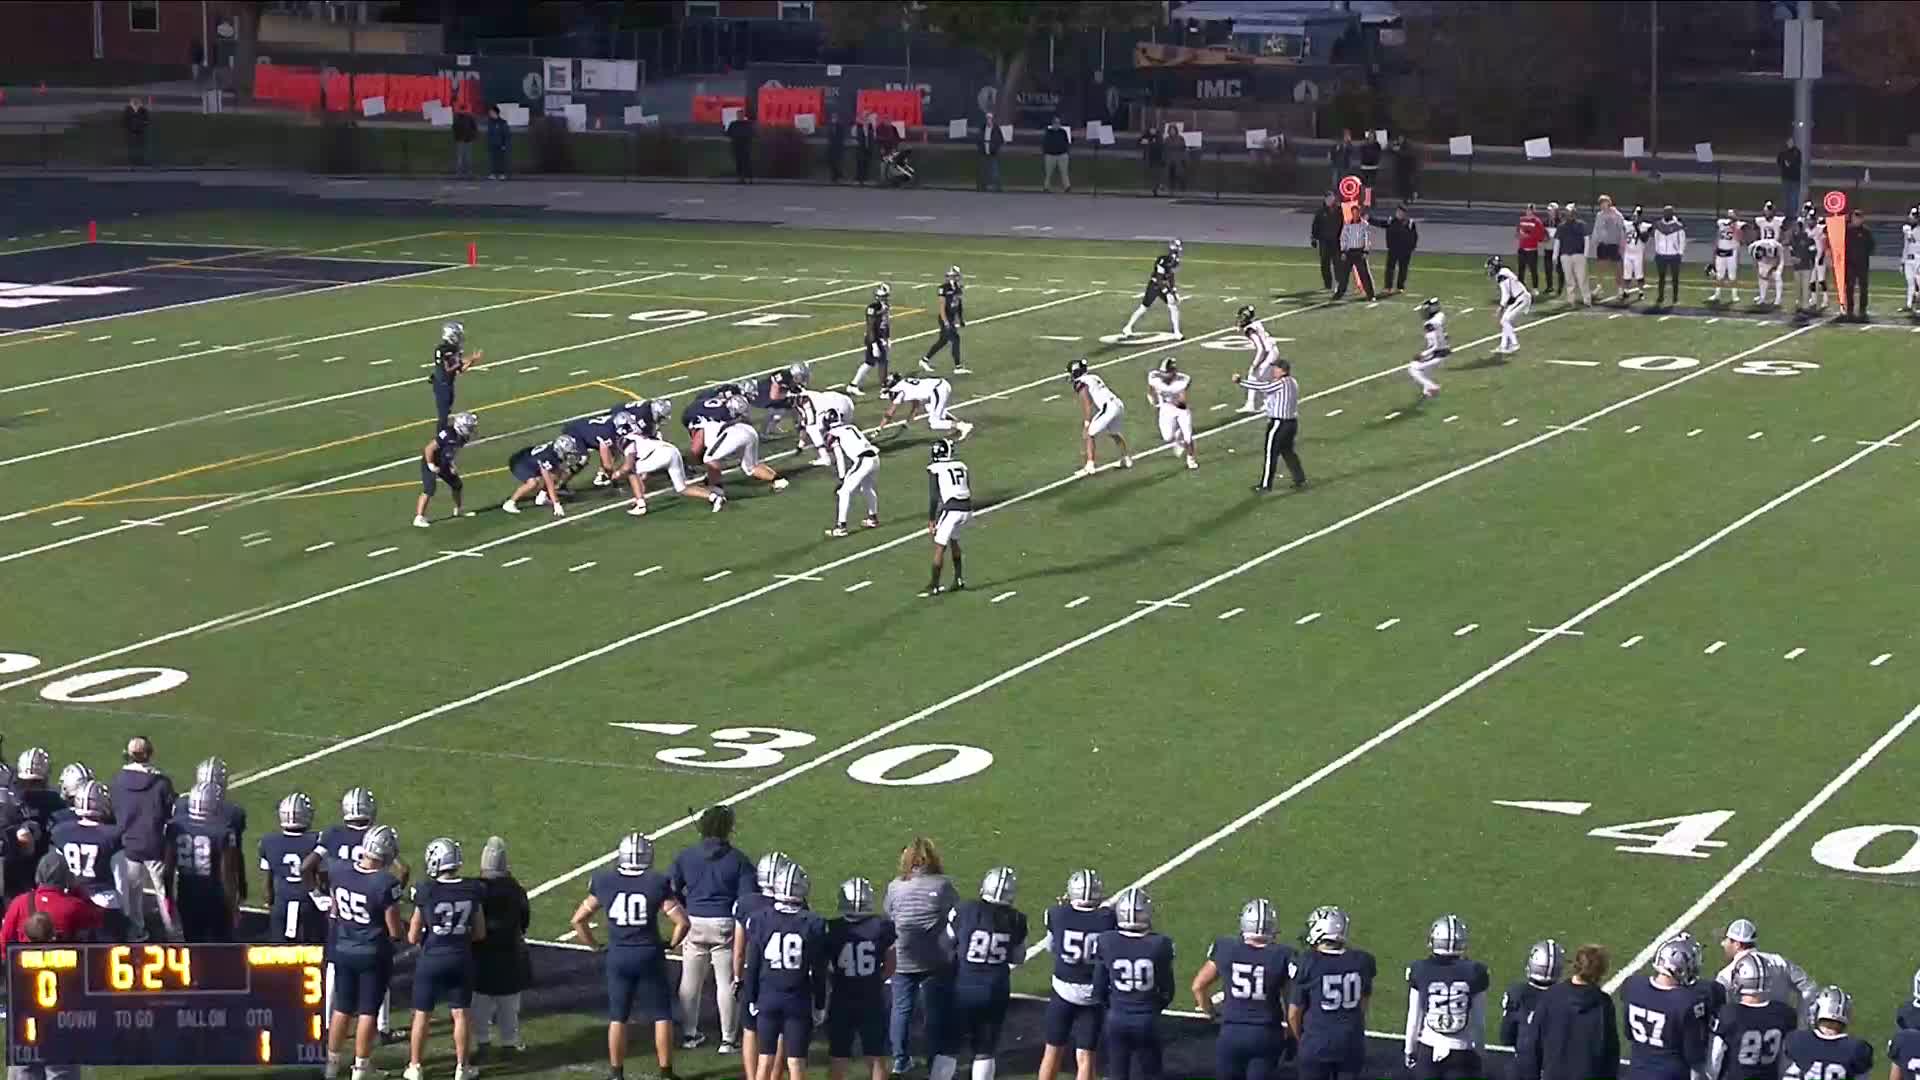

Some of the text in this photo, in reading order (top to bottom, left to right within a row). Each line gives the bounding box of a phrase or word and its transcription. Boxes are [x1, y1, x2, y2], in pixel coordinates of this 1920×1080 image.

[1197, 79, 1242, 99] IMC
[63, 842, 100, 878] 87
[335, 887, 371, 924] 65
[432, 900, 473, 936] 37
[608, 892, 648, 926] 40
[763, 932, 803, 970] 48
[837, 940, 877, 977] 46
[967, 930, 1011, 965] 85
[1112, 958, 1155, 993] 30
[1231, 962, 1266, 1001] 51
[1320, 972, 1362, 1011] 50
[1628, 1003, 1666, 1048] 57
[1738, 1028, 1783, 1066] 83
